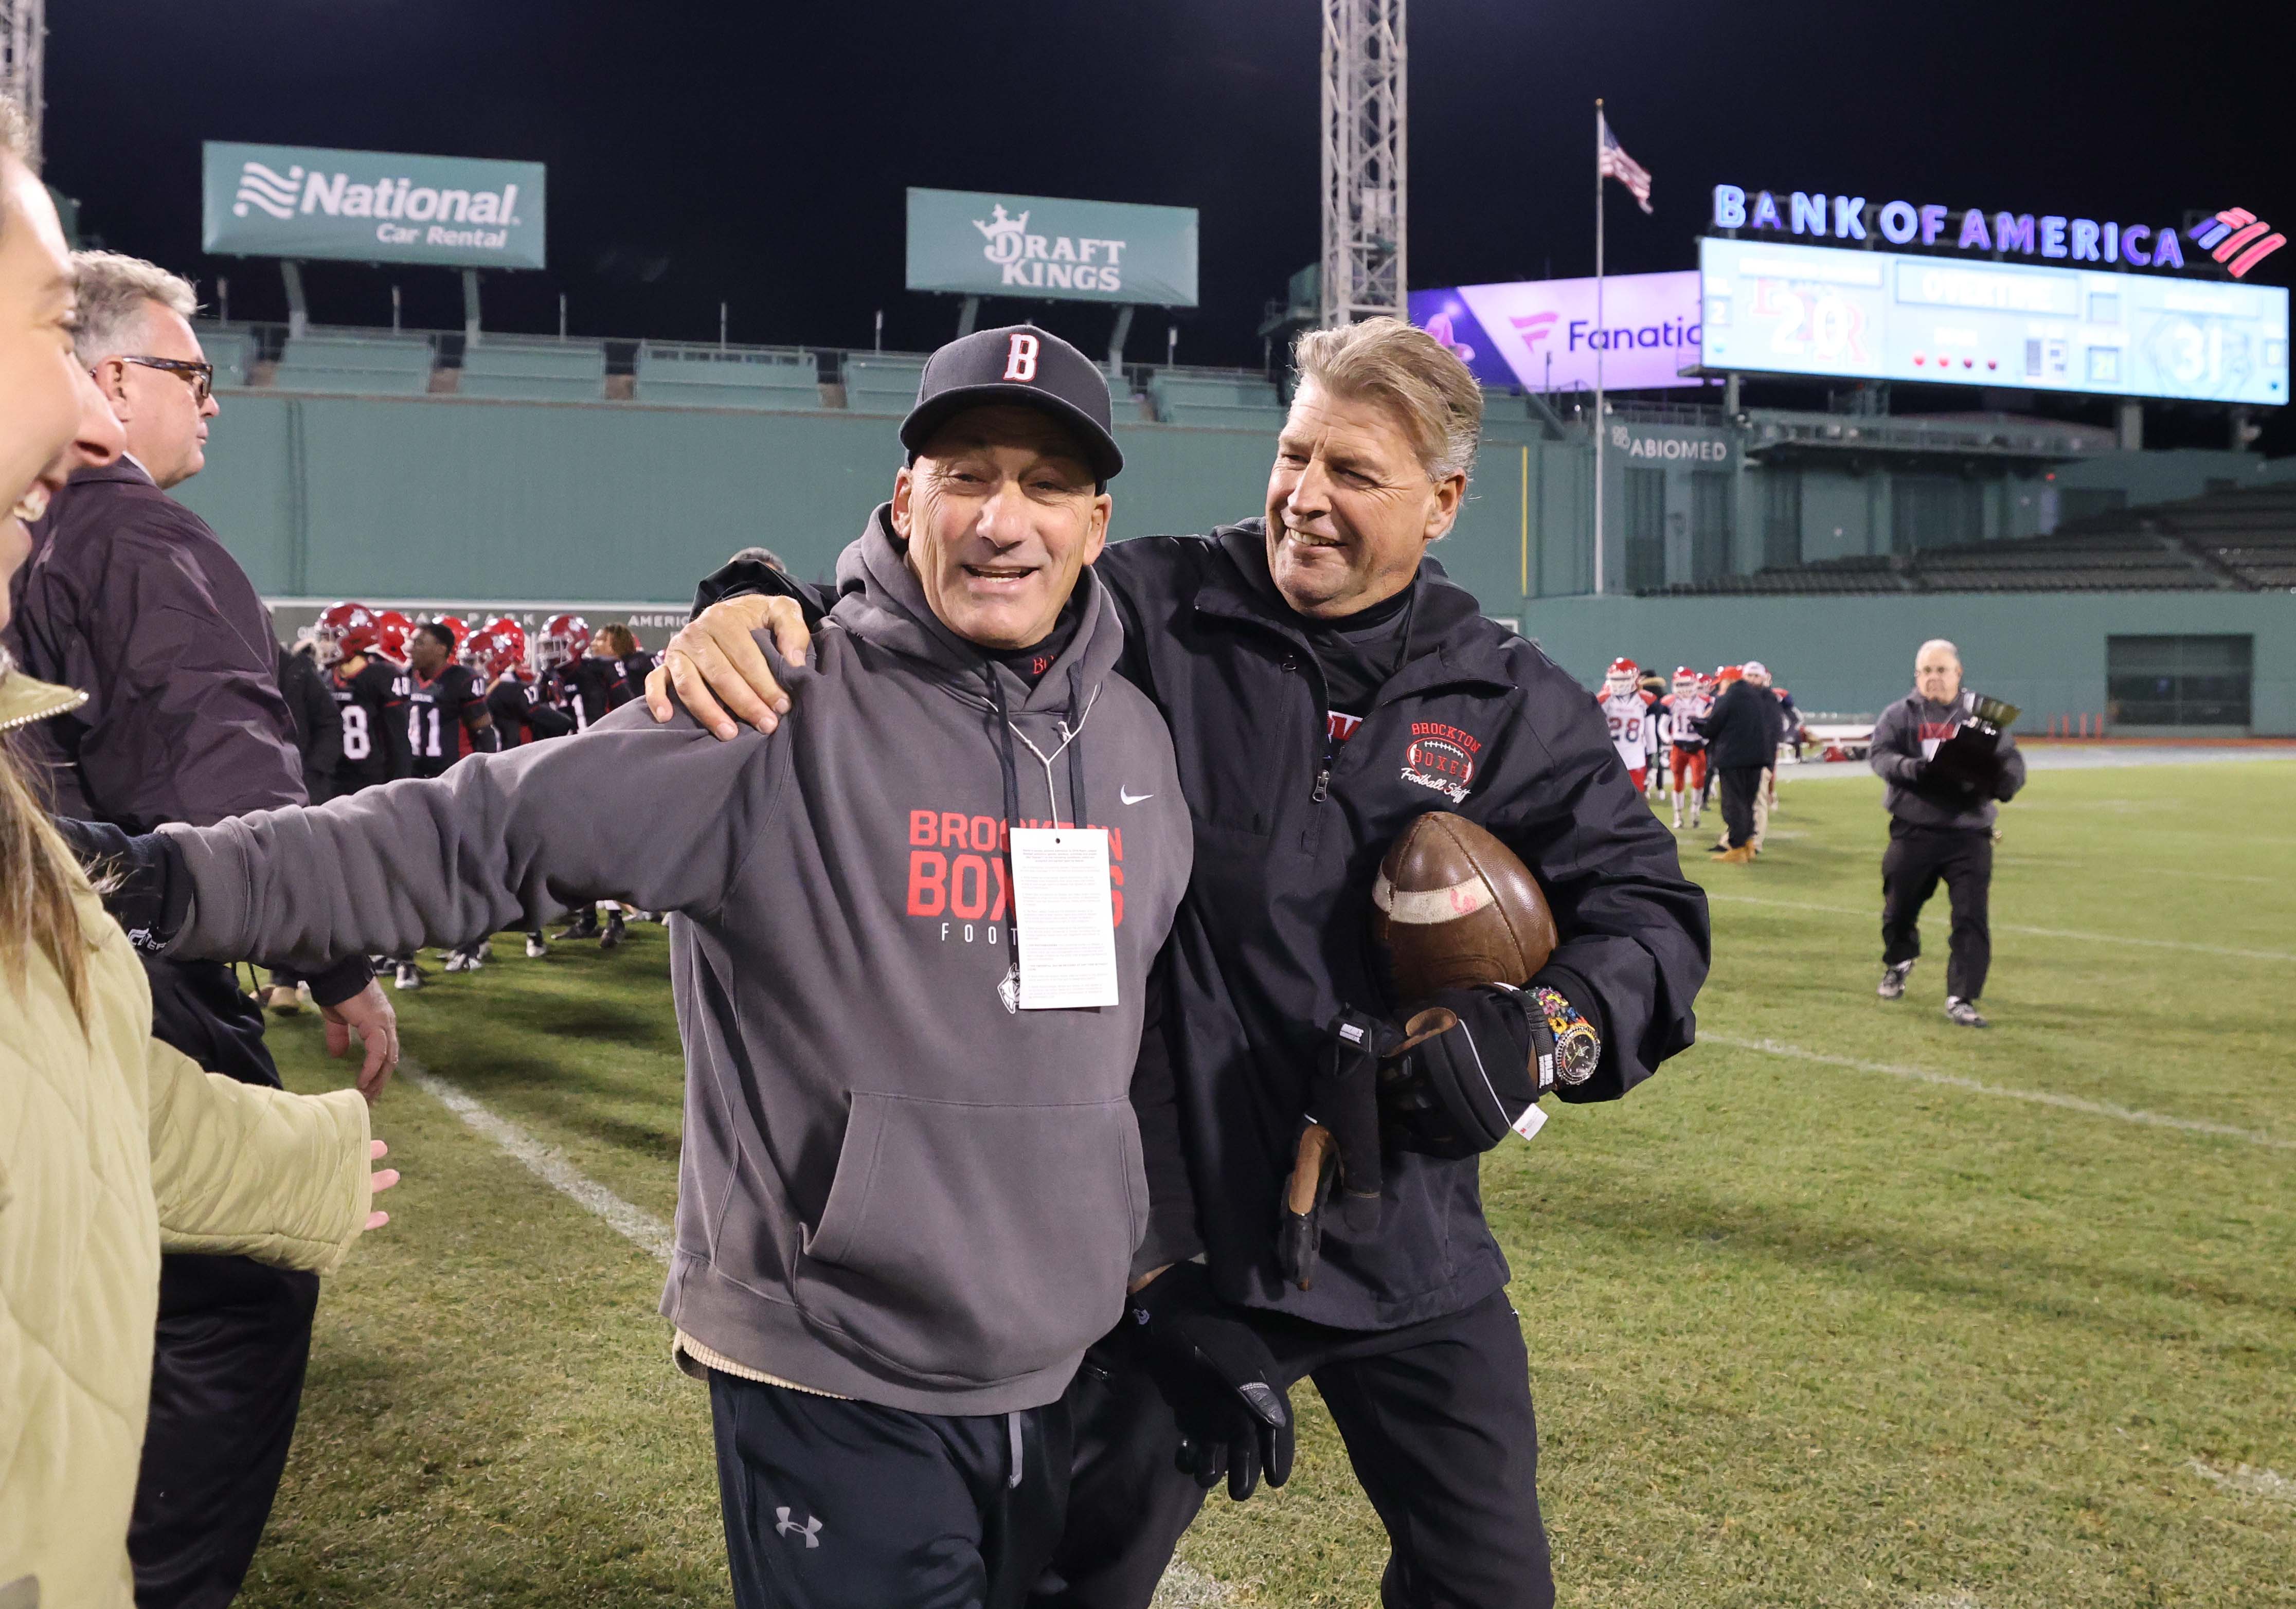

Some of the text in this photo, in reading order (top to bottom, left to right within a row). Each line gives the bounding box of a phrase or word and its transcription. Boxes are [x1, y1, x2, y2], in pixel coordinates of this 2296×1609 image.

[300, 172, 518, 225] National
[376, 223, 508, 248] Car Rental
[1714, 184, 2185, 268] BANK OF AMERICA
[983, 231, 1126, 264] DRAFT
[1001, 259, 1121, 292] KINGS
[1569, 316, 1701, 351] Fanatic
[1003, 334, 1040, 382] B
[1630, 439, 1727, 461] ABIOMED
[627, 614, 690, 628] AMERIC
[1411, 722, 1482, 753] BROCKTON
[1609, 717, 1640, 742] 28
[1401, 767, 1472, 804] Football Staff
[909, 810, 1123, 861] BRON
[941, 922, 1018, 946] FOOT
